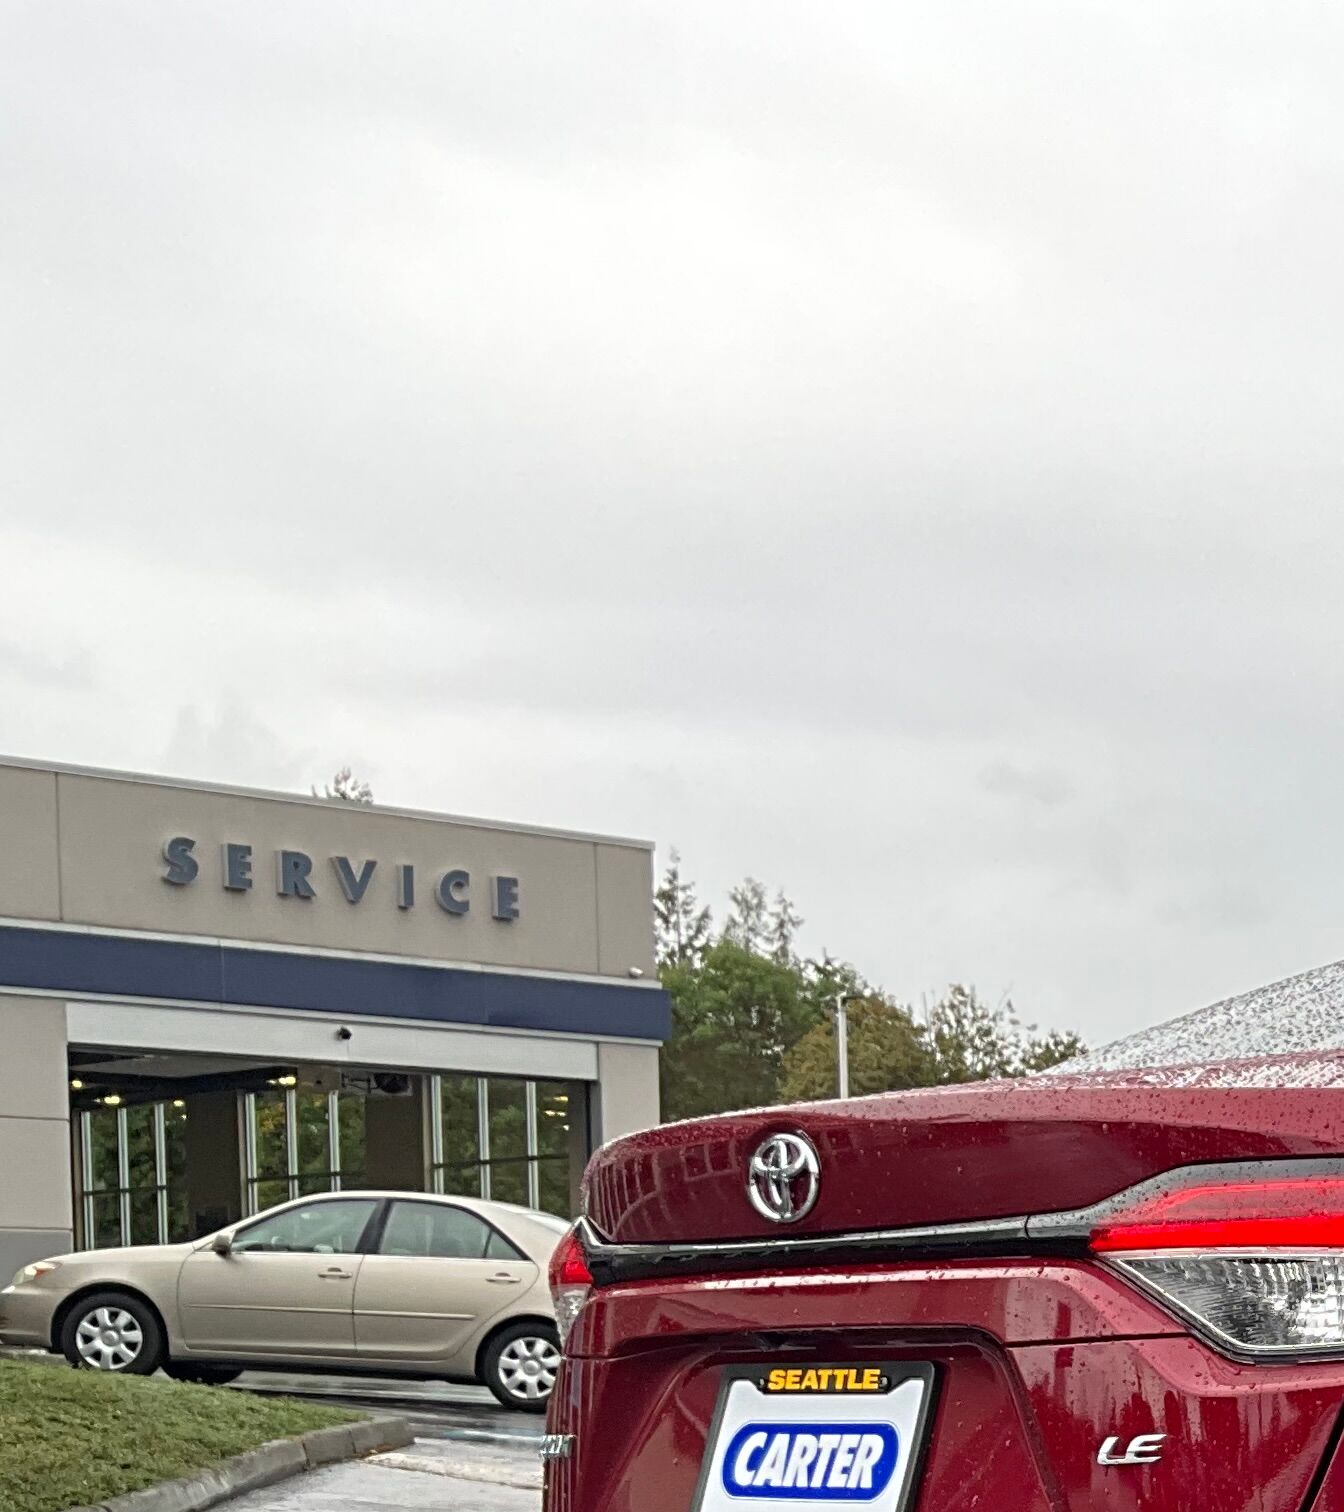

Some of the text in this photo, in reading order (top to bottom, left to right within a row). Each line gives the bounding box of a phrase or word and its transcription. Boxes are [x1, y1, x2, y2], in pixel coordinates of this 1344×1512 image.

[162, 836, 520, 920] SERVICE
[768, 1369, 881, 1390] SEATTLE
[733, 1431, 884, 1489] CARTER
[1097, 1433, 1167, 1465] LE
